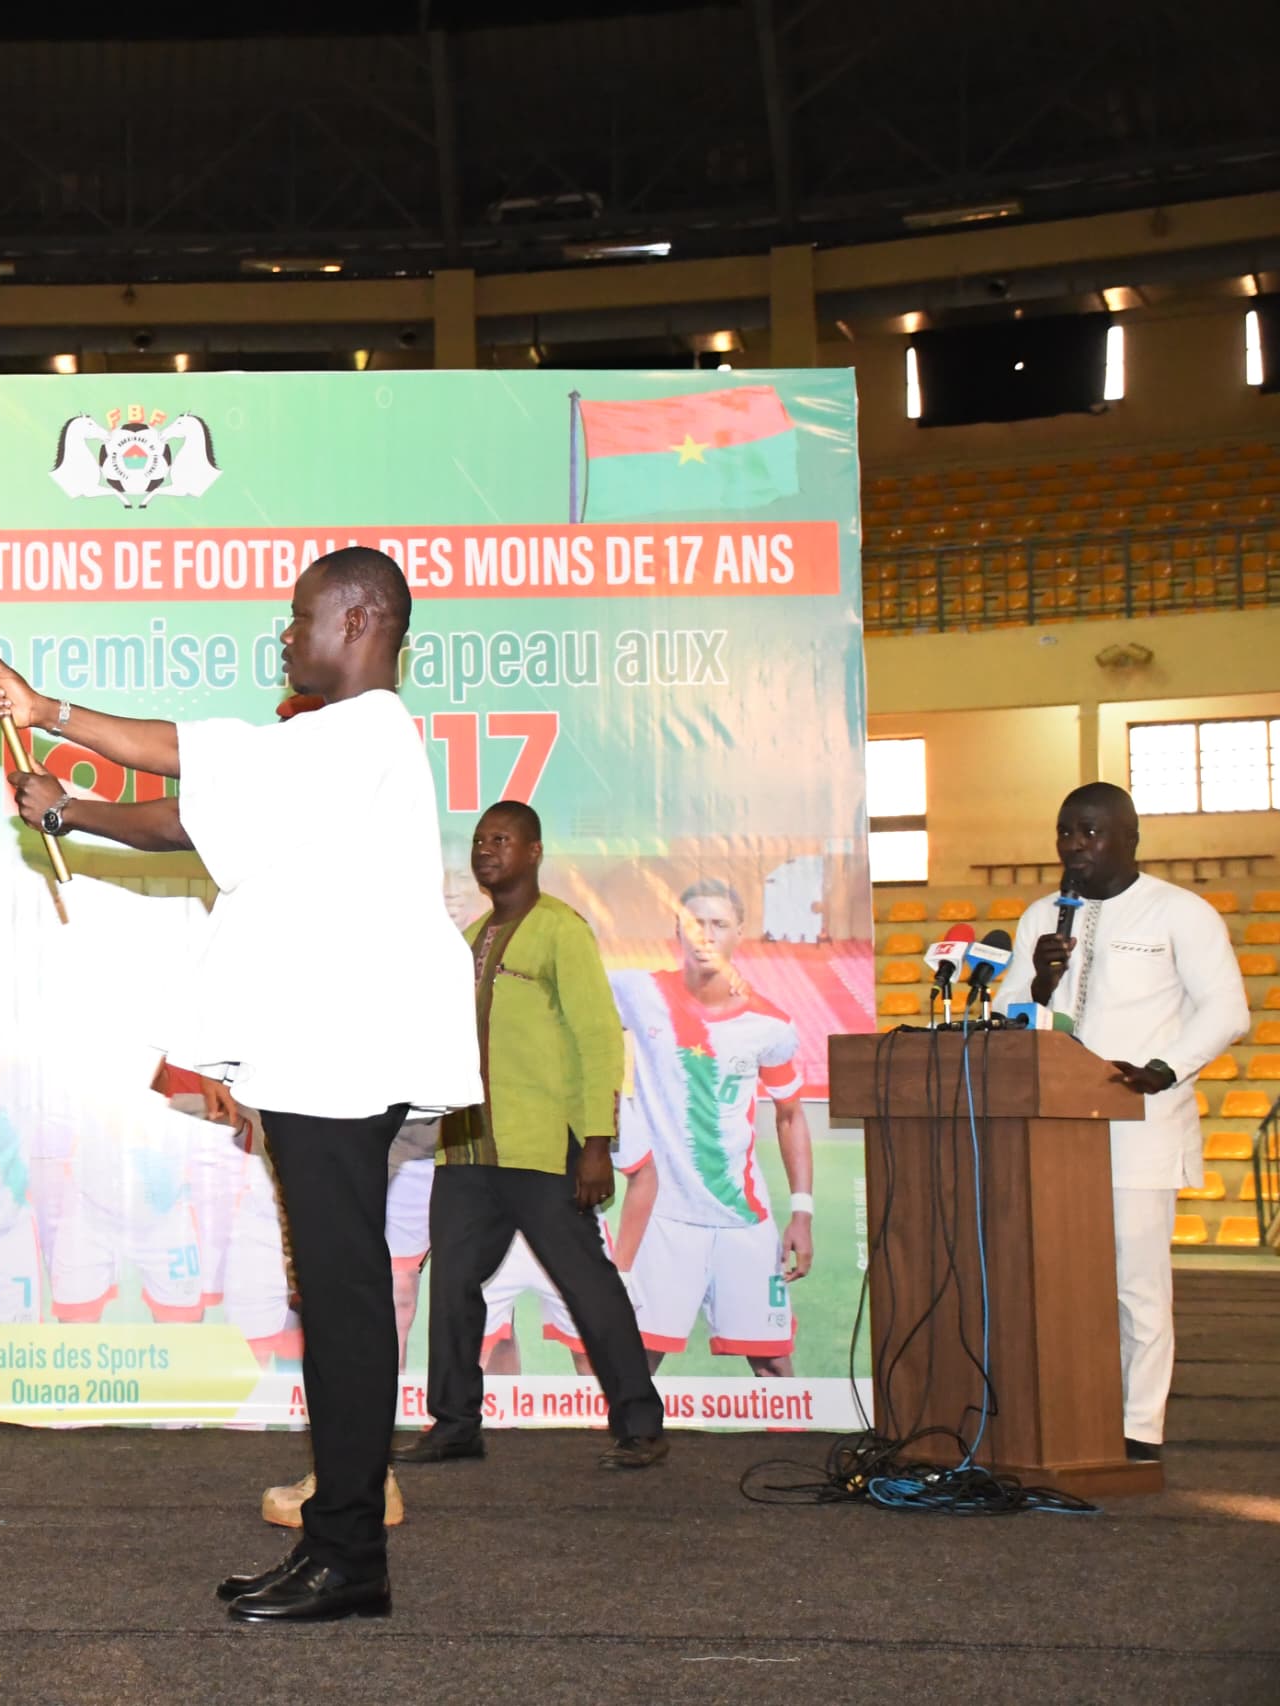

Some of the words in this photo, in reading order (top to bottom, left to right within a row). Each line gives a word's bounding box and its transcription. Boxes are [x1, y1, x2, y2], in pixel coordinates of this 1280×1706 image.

[106, 404, 168, 432] FBF
[114, 541, 163, 590] DE
[464, 536, 595, 587] MOINS
[606, 536, 656, 585] DE
[664, 535, 704, 585] 17
[713, 534, 795, 584] ANS
[31, 617, 238, 690] remise
[614, 629, 730, 687] aux
[411, 710, 560, 813] 17
[719, 1074, 743, 1105] 6
[167, 1243, 201, 1281] 20
[53, 1343, 92, 1369] des
[97, 1343, 169, 1375] Sports
[12, 1378, 80, 1411] Ouaga
[85, 1379, 140, 1405] 2000
[513, 1386, 534, 1417] la
[542, 1386, 609, 1418] natio
[701, 1388, 813, 1421] soutient
